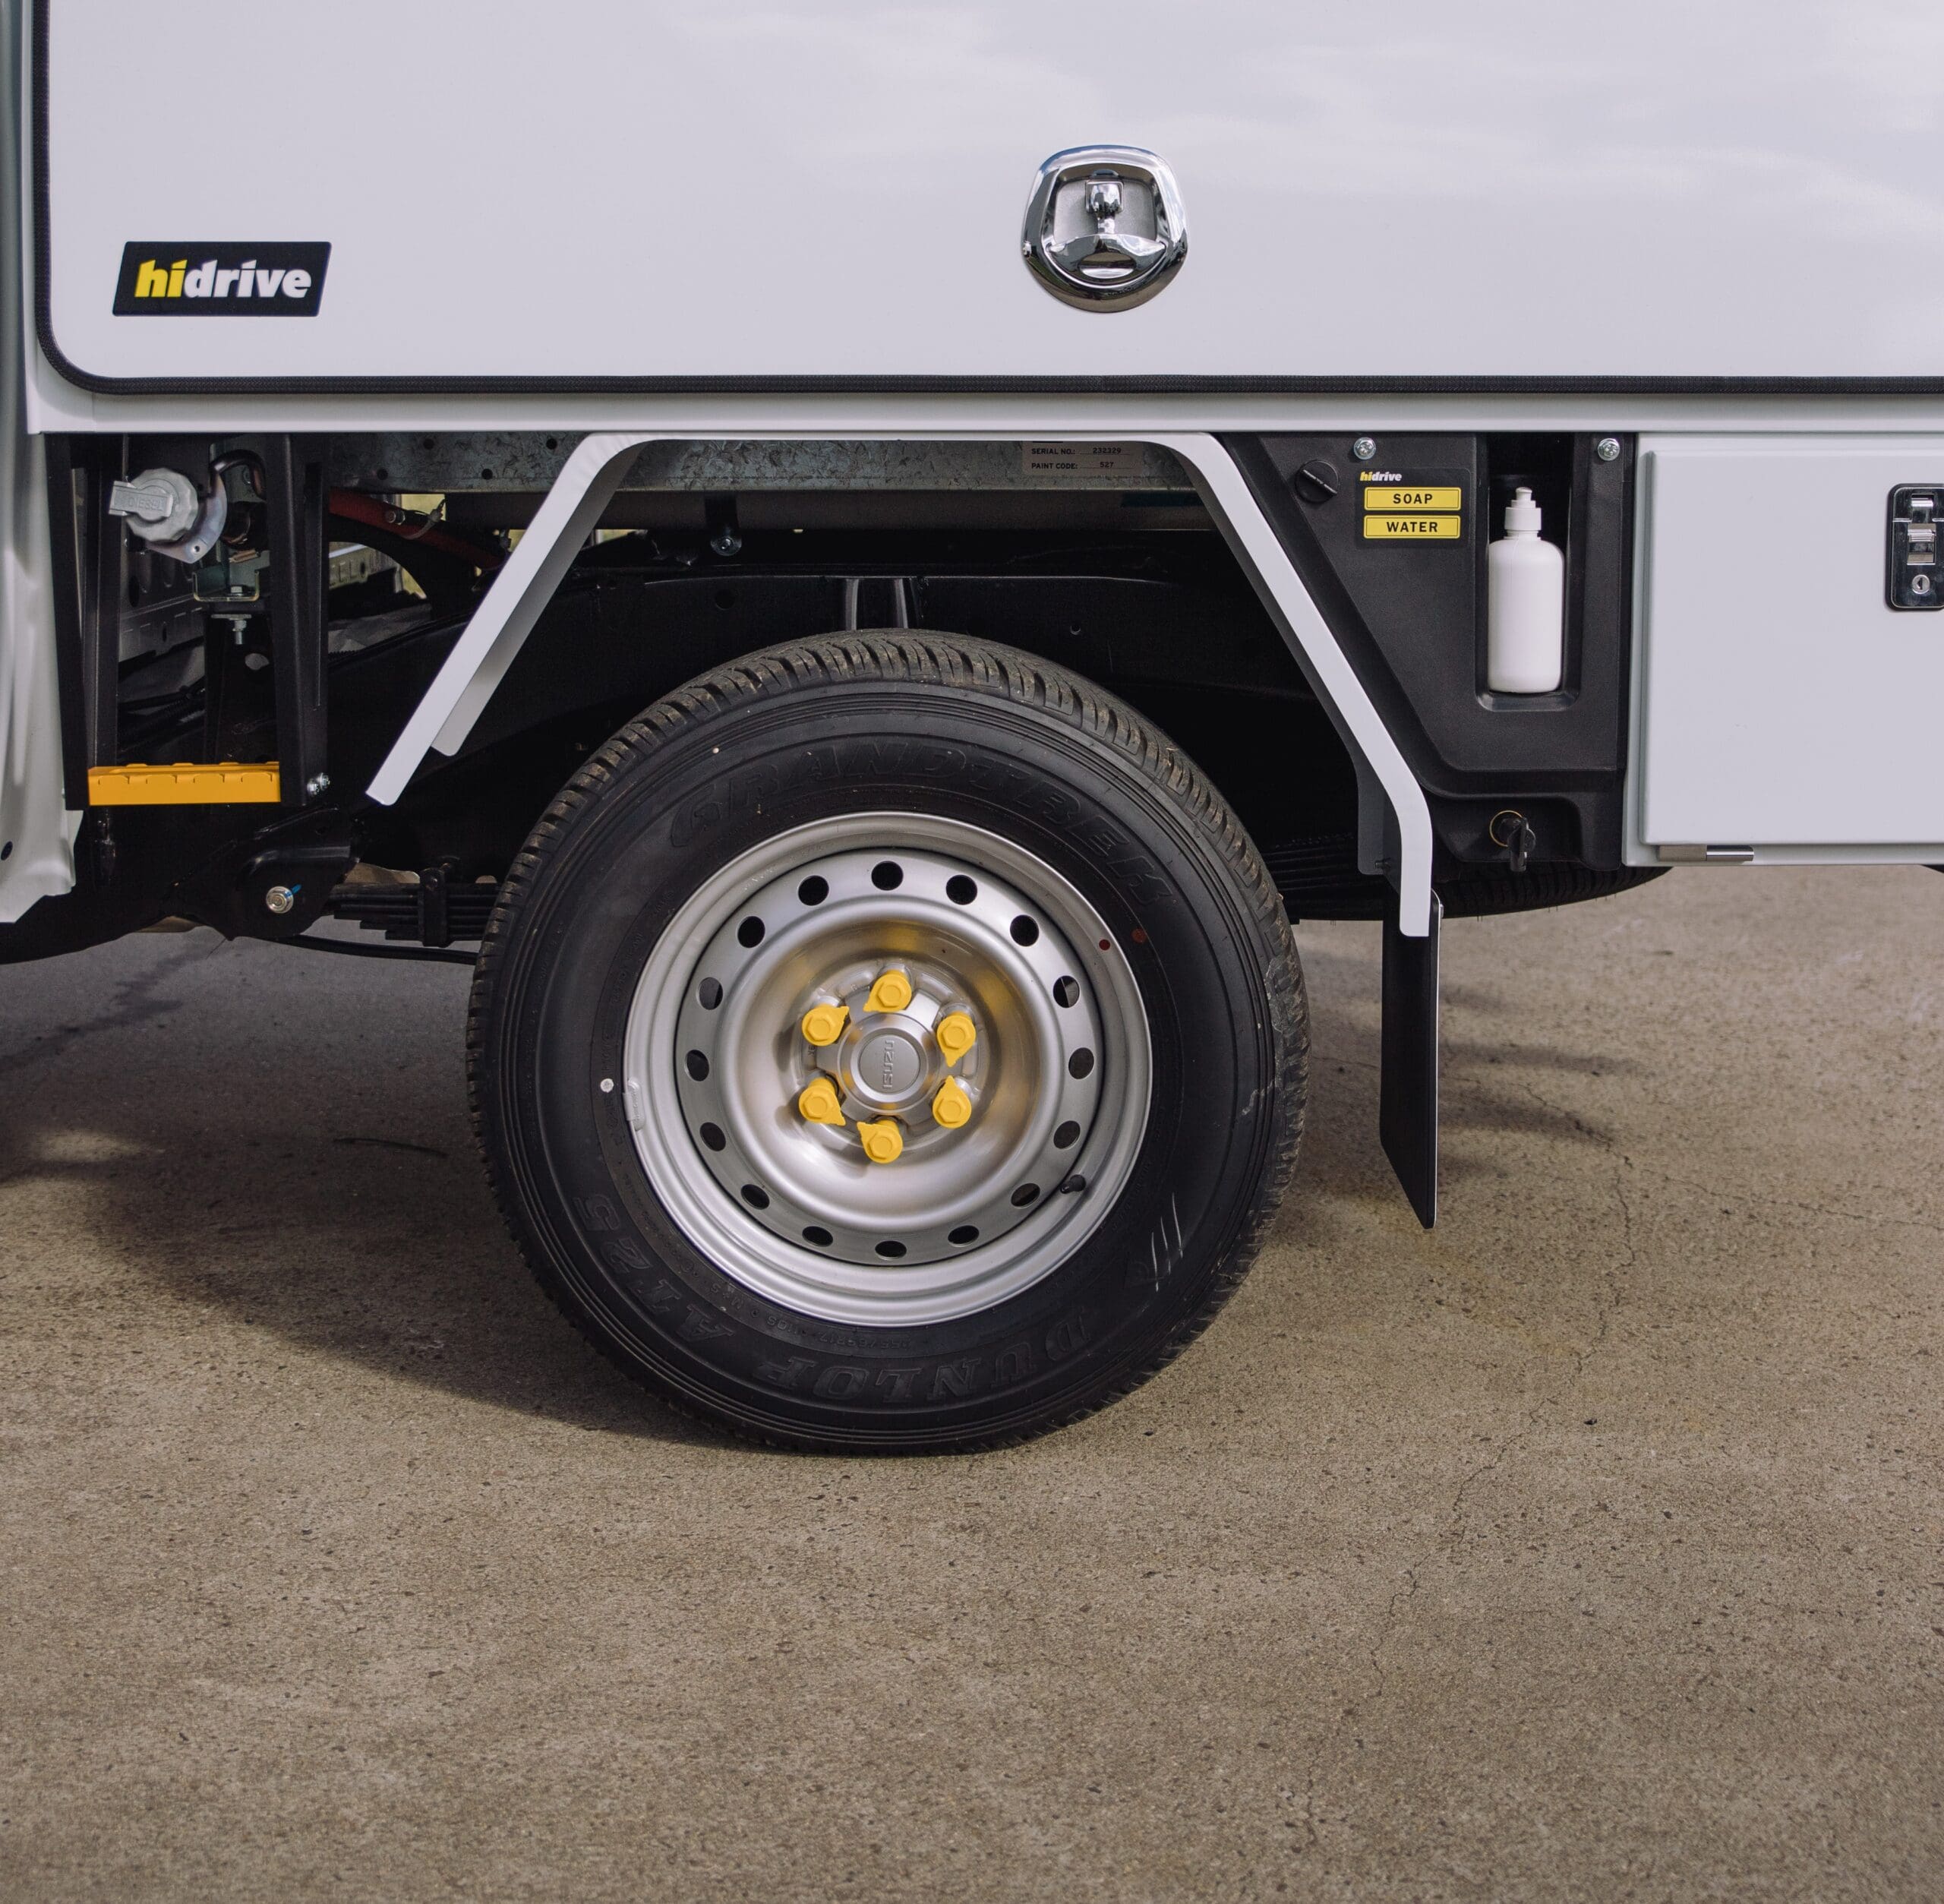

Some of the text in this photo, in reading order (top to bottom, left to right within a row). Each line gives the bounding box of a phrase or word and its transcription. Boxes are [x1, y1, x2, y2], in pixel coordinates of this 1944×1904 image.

[134, 259, 312, 298] hidrive
[1359, 471, 1403, 482] hidrive
[1393, 493, 1433, 504] SOAP
[1387, 521, 1438, 532] WATER
[671, 741, 1173, 907] GRANDTREK
[882, 1040, 895, 1089] ISUZU
[753, 1305, 1092, 1405] DUNLOP
